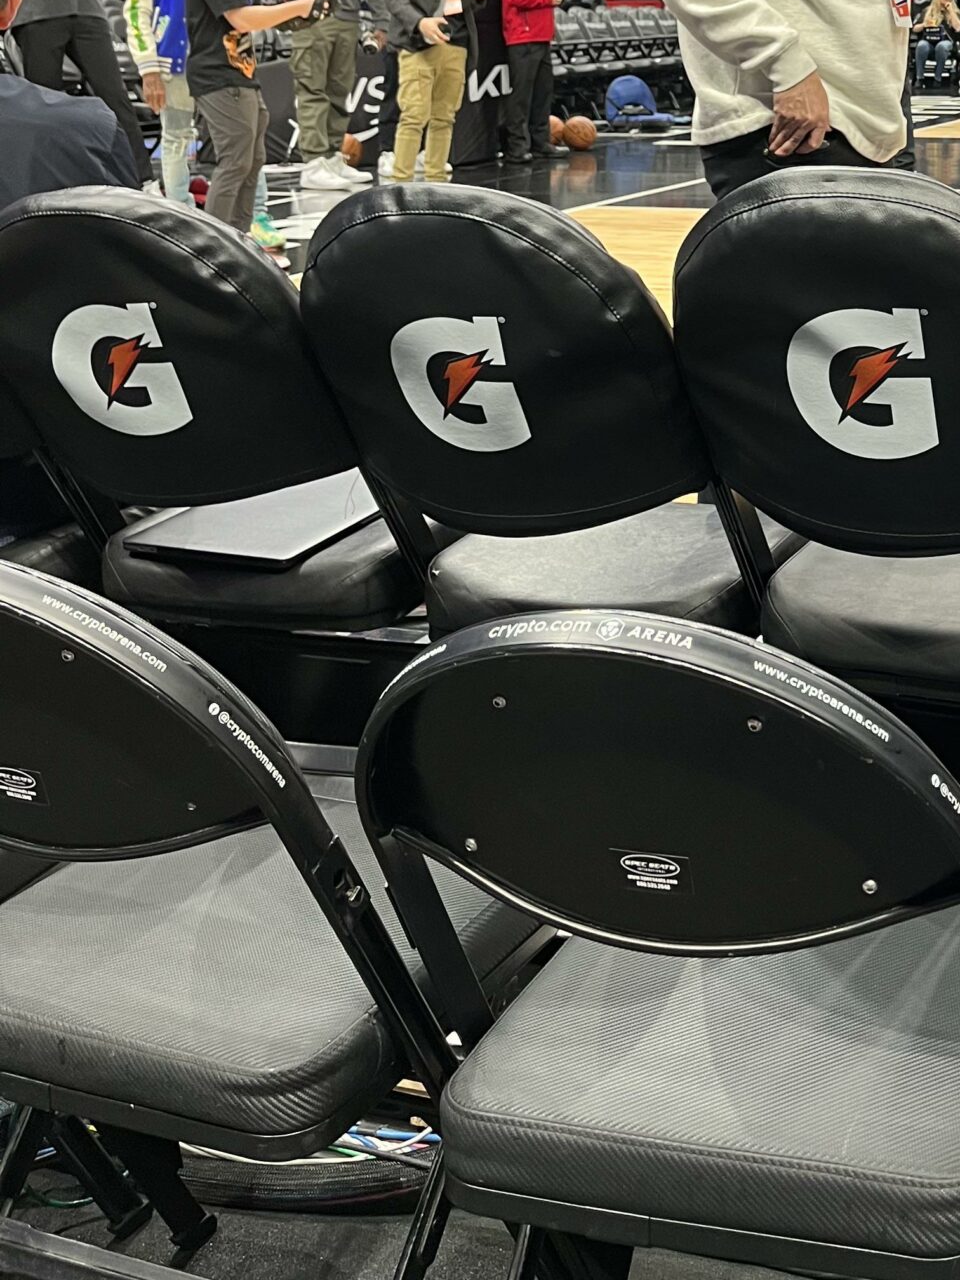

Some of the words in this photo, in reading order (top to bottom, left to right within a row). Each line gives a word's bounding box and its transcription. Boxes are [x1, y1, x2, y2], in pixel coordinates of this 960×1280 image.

[51, 302, 194, 436] G
[390, 316, 532, 452] G
[786, 308, 939, 460] G
[41, 594, 168, 673] www.cryptoarena.com
[488, 617, 591, 640] crypto.com
[627, 624, 694, 650] ARENA
[753, 659, 890, 743] www.cryptoarena.com
[217, 711, 287, 790] @cryptocomarena
